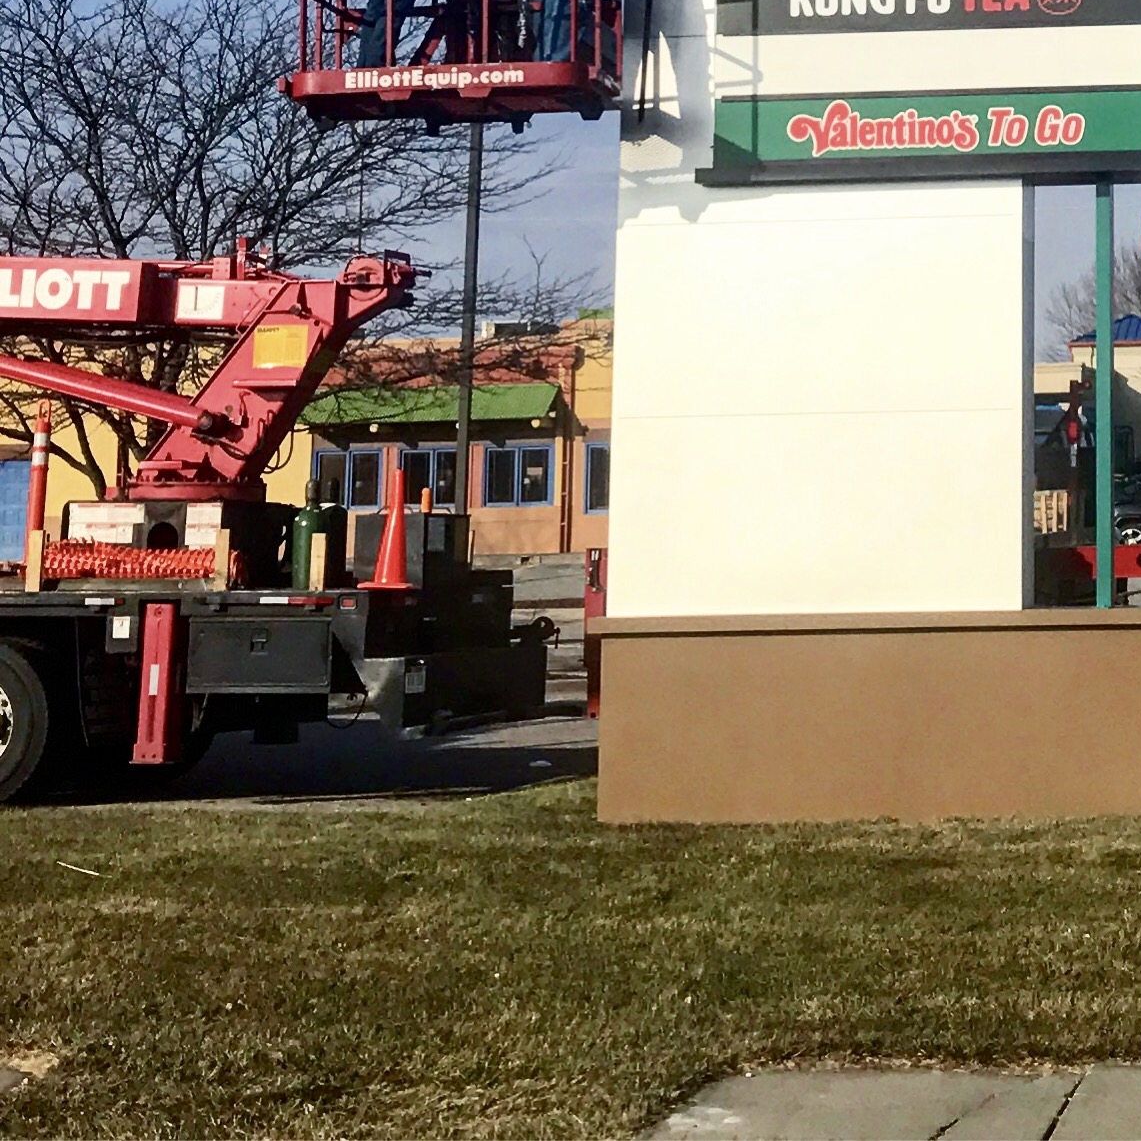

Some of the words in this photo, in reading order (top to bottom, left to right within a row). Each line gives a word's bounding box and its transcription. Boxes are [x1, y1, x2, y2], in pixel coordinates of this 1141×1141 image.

[344, 67, 525, 89] ElliottEquip.com
[787, 99, 980, 157] Valentino's
[988, 107, 1029, 147] To
[1034, 104, 1086, 146] Go
